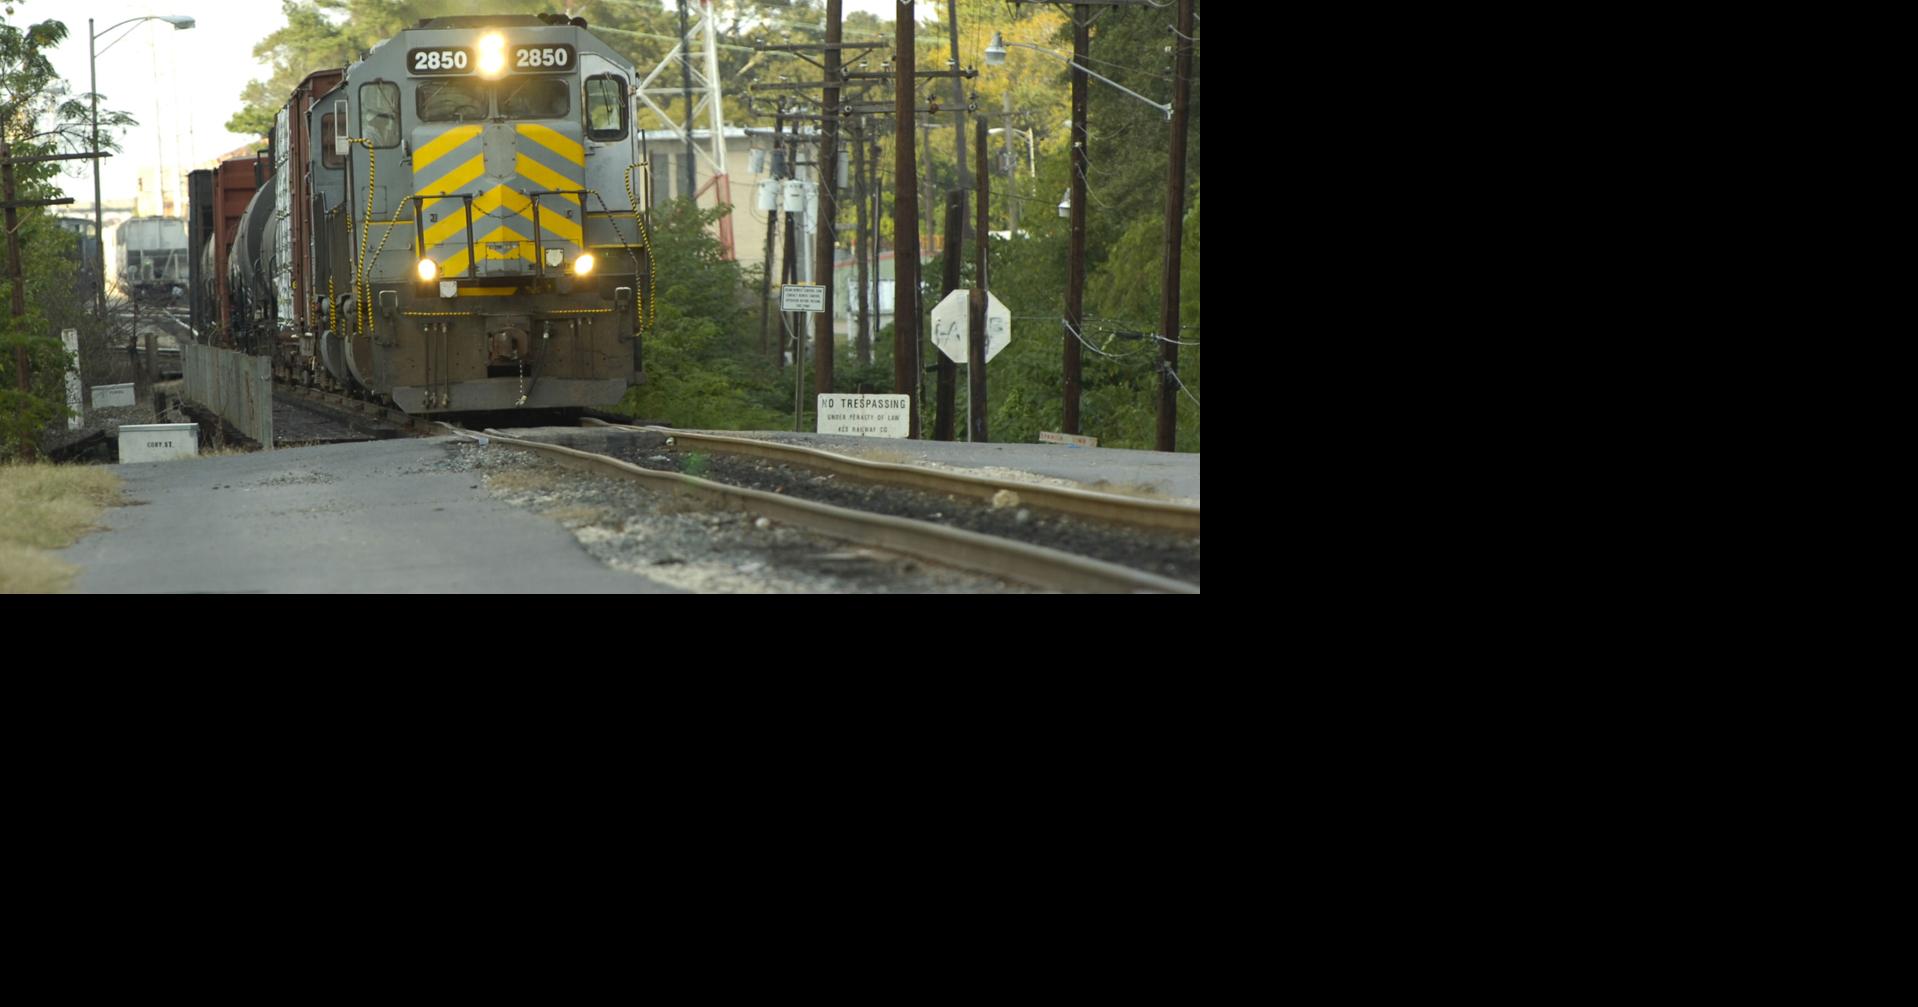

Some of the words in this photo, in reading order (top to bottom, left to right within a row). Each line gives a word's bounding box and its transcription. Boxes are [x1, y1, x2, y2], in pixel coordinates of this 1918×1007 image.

[415, 51, 468, 70] 2850
[516, 48, 568, 67] 2850
[822, 398, 834, 409] NO
[841, 398, 906, 409] TRESPASSING
